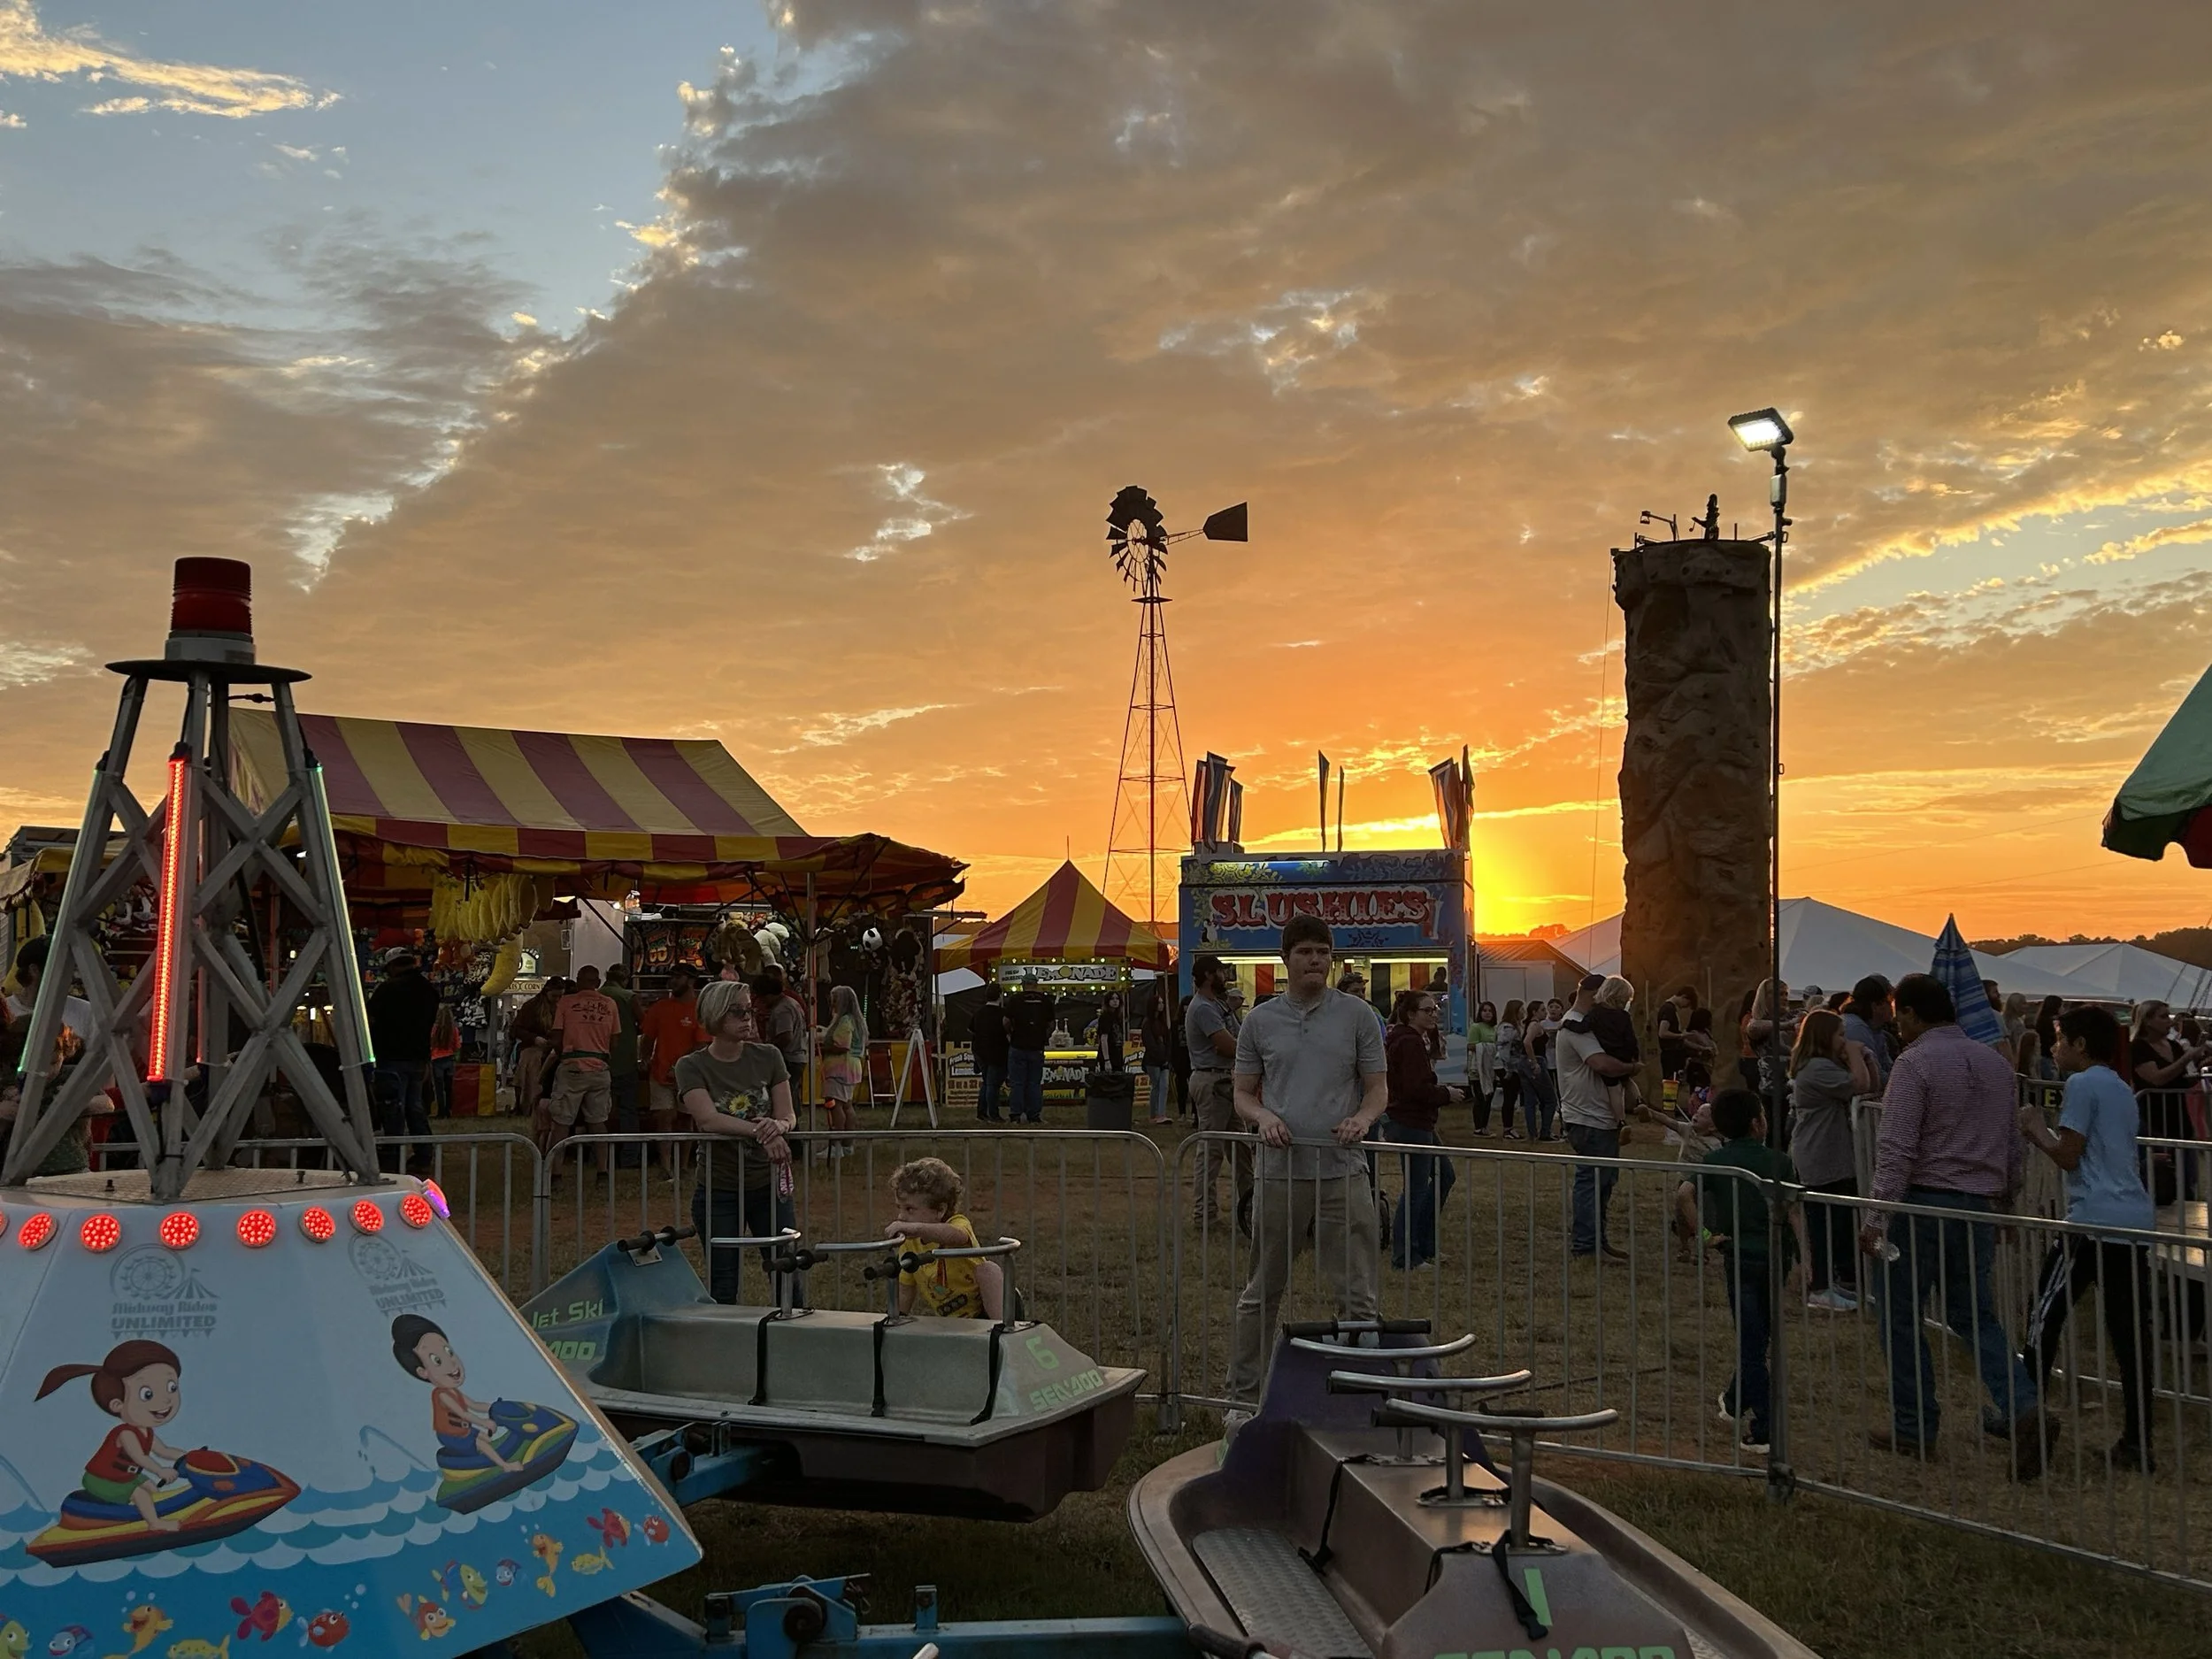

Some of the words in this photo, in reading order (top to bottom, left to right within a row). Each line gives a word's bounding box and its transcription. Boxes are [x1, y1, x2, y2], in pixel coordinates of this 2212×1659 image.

[1210, 888, 1432, 928] SLUSHIES
[112, 1301, 175, 1317] Midway
[375, 1288, 444, 1310] UNLIMITED
[567, 1298, 603, 1323] Ski
[111, 1315, 216, 1329] UNLIMITED
[1026, 1337, 1060, 1371] 6
